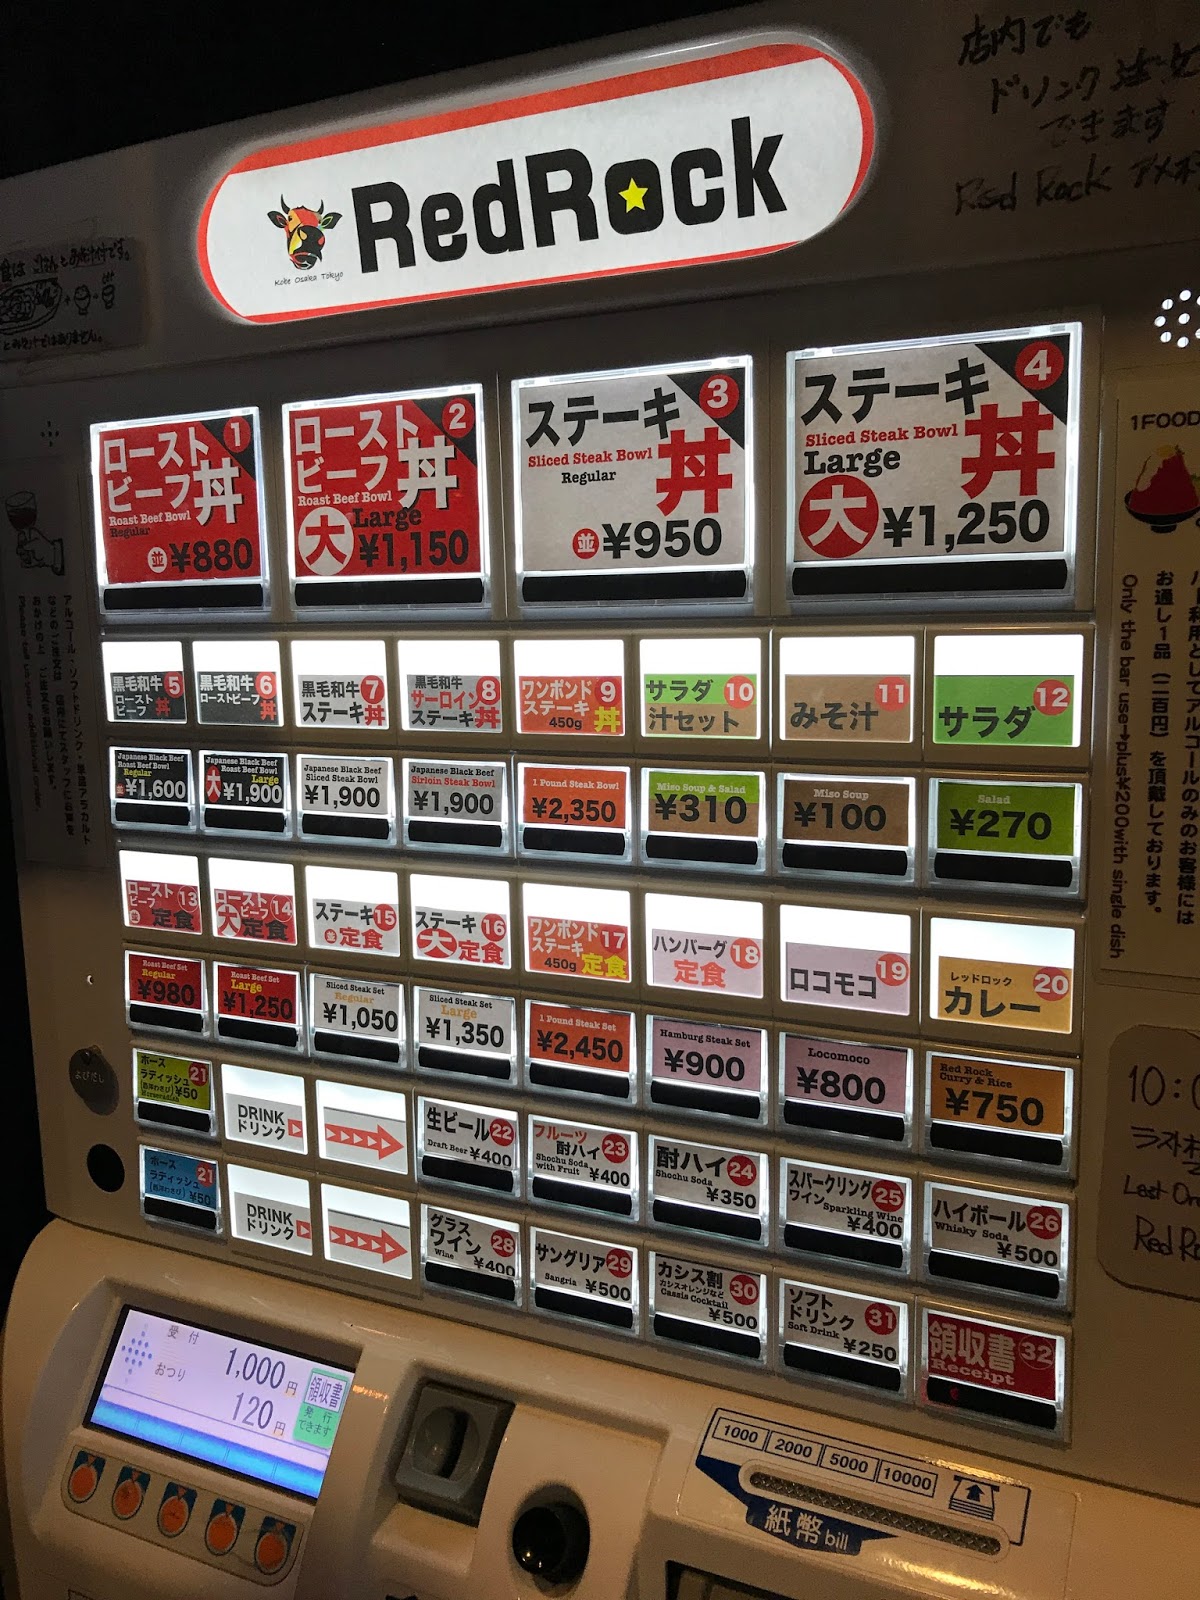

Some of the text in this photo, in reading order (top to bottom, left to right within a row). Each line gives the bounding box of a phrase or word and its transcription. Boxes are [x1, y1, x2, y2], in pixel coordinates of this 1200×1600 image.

[351, 115, 788, 274] RedRock
[295, 273, 318, 284] Osaka
[320, 271, 343, 282] Tokyo
[799, 349, 1051, 425] ステーキ 4
[448, 404, 466, 430] 2
[525, 378, 729, 449] ステーキ 3
[805, 423, 958, 448] Sliced Steak Bowl
[528, 447, 653, 468] Sliced Steak Bowl
[804, 447, 901, 478] Large
[561, 468, 616, 486] Regular
[298, 491, 393, 507] Roast Beef Bowl
[109, 510, 192, 526] Roast Beef Bowl
[353, 506, 422, 532] Large
[883, 499, 1049, 552] ¥1,250
[109, 526, 151, 539] Regular
[602, 517, 722, 560] ¥950
[169, 537, 253, 573] ¥880
[358, 529, 469, 573] ¥1,150
[200, 674, 254, 691] 黒毛和牛
[301, 680, 360, 698] 黒毛和牛
[415, 675, 463, 689] 黒毛和牛
[646, 679, 753, 702] サラダ 10
[523, 700, 589, 716] ステーキ
[790, 684, 905, 730] みそ汁 11
[938, 687, 1069, 738] サラダ 12
[549, 717, 583, 731] 450g
[648, 707, 739, 732] 汁セット
[1109, 574, 1138, 958] Only the bar single dish
[125, 778, 186, 800] ¥1,600
[251, 774, 279, 786] Large
[223, 782, 282, 804] ¥1,900
[304, 784, 381, 808] ¥1,900
[413, 790, 494, 815] ¥1,900
[813, 788, 868, 801] Miso Soup
[977, 794, 1010, 805] Salad
[532, 796, 616, 823] ¥2,350
[655, 793, 747, 825] ¥310
[794, 801, 886, 832] ¥100
[950, 808, 1052, 840] ¥270
[316, 902, 395, 925] ステーキ 15
[415, 911, 506, 935] ステーキ 16
[602, 931, 626, 949] 17
[654, 936, 759, 964] ハンバーグ 18
[142, 969, 176, 981] Regular
[544, 957, 577, 973] 450g
[674, 959, 726, 988] 定食
[137, 978, 195, 1006] ¥980
[231, 979, 262, 994] Large
[790, 961, 907, 999] ロコモコ 19
[223, 990, 293, 1020] ¥1,250
[945, 973, 1069, 1018] カレー 20
[323, 1002, 399, 1032] ¥1,050
[440, 1005, 478, 1020] Large
[426, 1016, 504, 1048] ¥1,350
[660, 1028, 752, 1049] Hamburg Steak Set
[537, 1029, 623, 1063] ¥2,450
[807, 1047, 871, 1065] Locomoco
[664, 1048, 745, 1082] ¥900
[965, 1065, 993, 1077] Rock
[796, 1066, 886, 1105] ¥800
[939, 1071, 1012, 1088] Curry Rice
[238, 1104, 285, 1125] DRINK
[945, 1087, 1044, 1127] ¥750
[238, 1119, 285, 1140] ドリンク
[427, 1107, 513, 1142] 生ビール 22
[470, 1146, 512, 1167] ¥400
[535, 1153, 567, 1166] Shochu
[603, 1140, 628, 1157] 23
[656, 1145, 757, 1180] 酎ハイ 24
[589, 1167, 629, 1187] ¥400
[655, 1170, 690, 1182] Shochu
[706, 1187, 757, 1210] ¥350
[876, 1190, 904, 1207] 25
[247, 1203, 293, 1226] DRINK
[933, 1200, 1059, 1232] ハイボール 26
[247, 1218, 294, 1240] ドリンク
[847, 1216, 902, 1239] ¥400
[982, 1230, 1009, 1242] Soda
[491, 1235, 515, 1253] 28
[997, 1241, 1058, 1267] ¥500
[473, 1256, 516, 1278] ¥400
[535, 1243, 632, 1273] サングリア 29
[544, 1271, 631, 1302] Sangria ¥500
[658, 1262, 758, 1299] カシス割 30
[709, 1307, 758, 1331] ¥500
[789, 1304, 896, 1332] ドリンク 31
[810, 1326, 840, 1340] Drink
[843, 1337, 897, 1362] ¥250
[929, 1320, 1016, 1374] 領収書
[155, 1362, 186, 1382] おつり
[226, 1347, 299, 1396] 1,000 円
[931, 1358, 1015, 1386] Receipt
[308, 1376, 345, 1409] 領収書
[232, 1392, 287, 1437] 120 円
[724, 1424, 932, 1491] 1000 2000 5000 10000
[825, 1529, 849, 1551] bill
